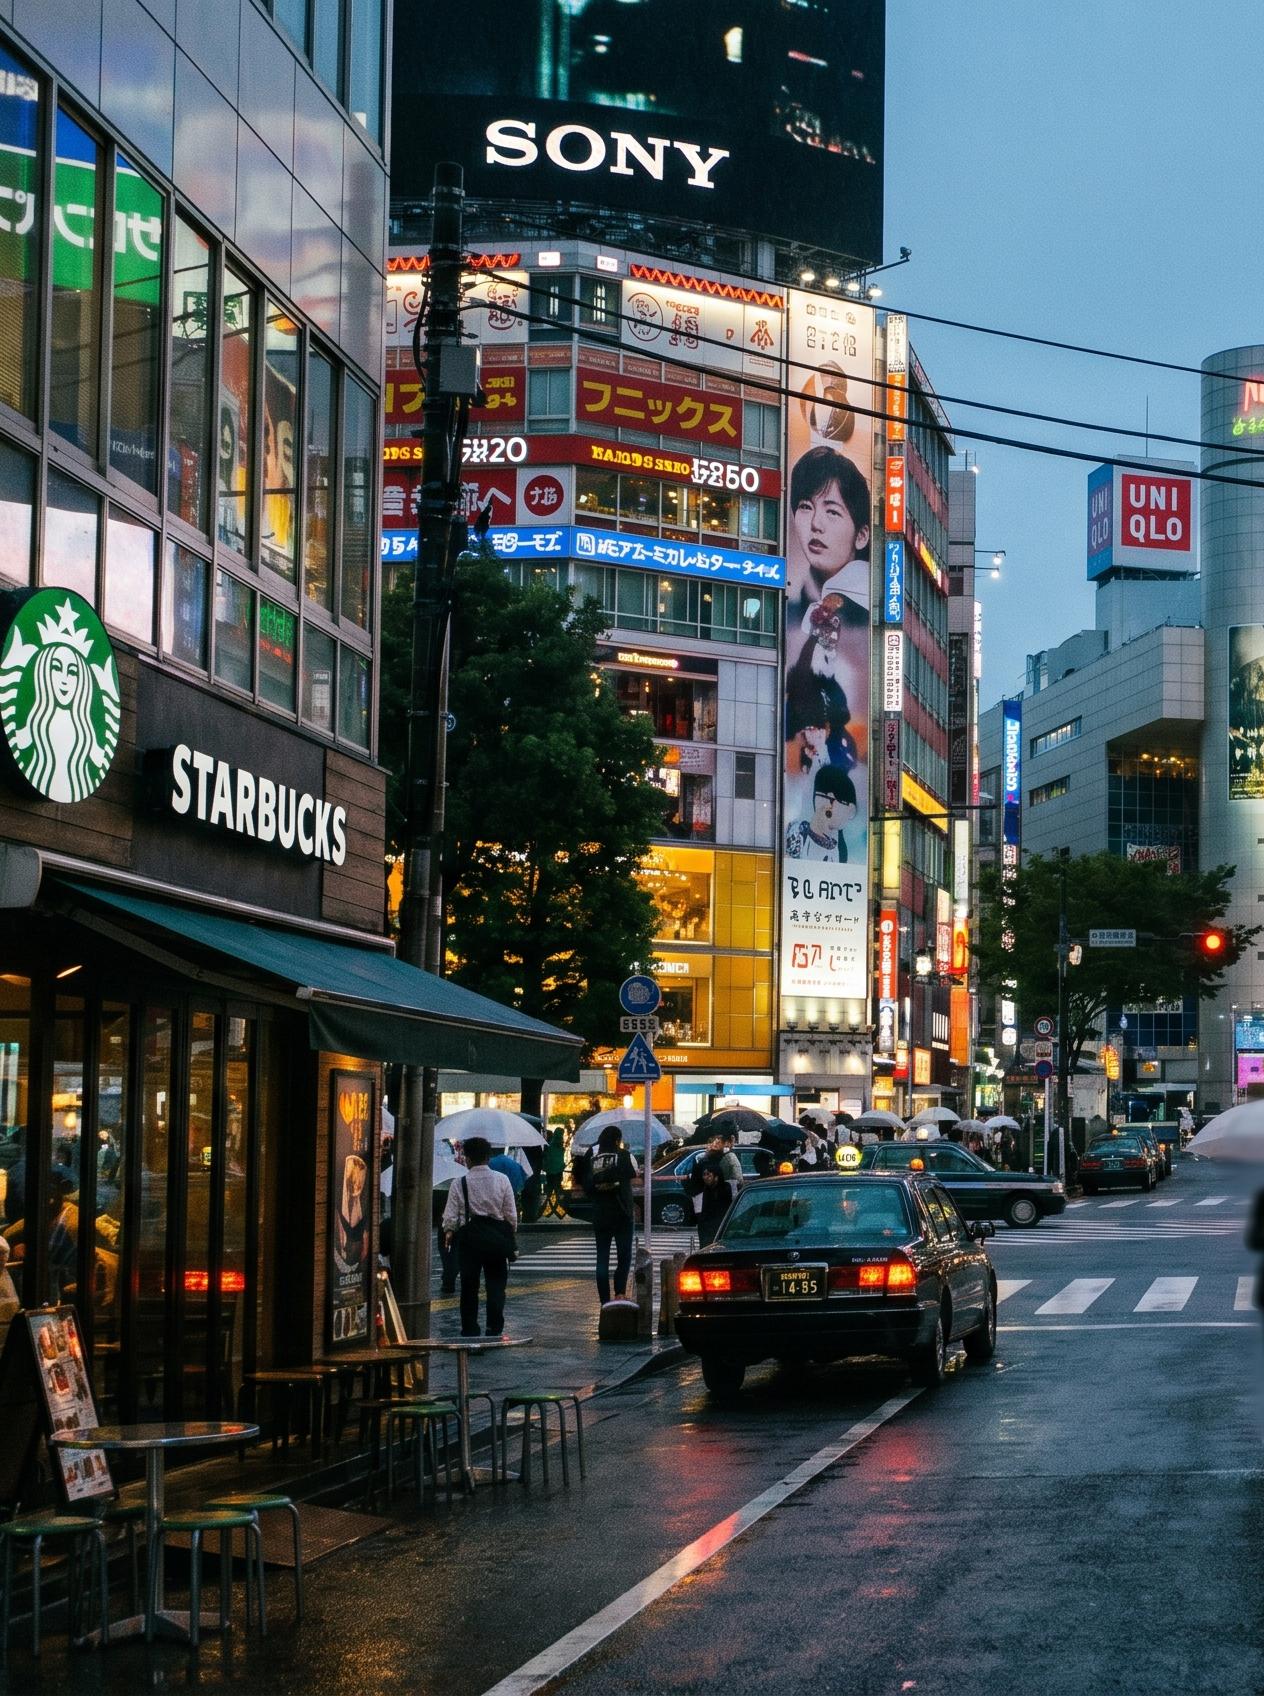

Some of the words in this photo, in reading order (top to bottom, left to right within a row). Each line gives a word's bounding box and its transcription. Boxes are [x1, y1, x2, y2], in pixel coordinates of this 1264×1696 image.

[486, 119, 730, 190] SONY
[582, 380, 738, 438] フニックス
[1091, 486, 1108, 518] UNI
[1129, 484, 1179, 511] UNI
[1090, 518, 1109, 550] QLO
[1129, 514, 1183, 543] QLO
[171, 743, 347, 867] STARBUCKS
